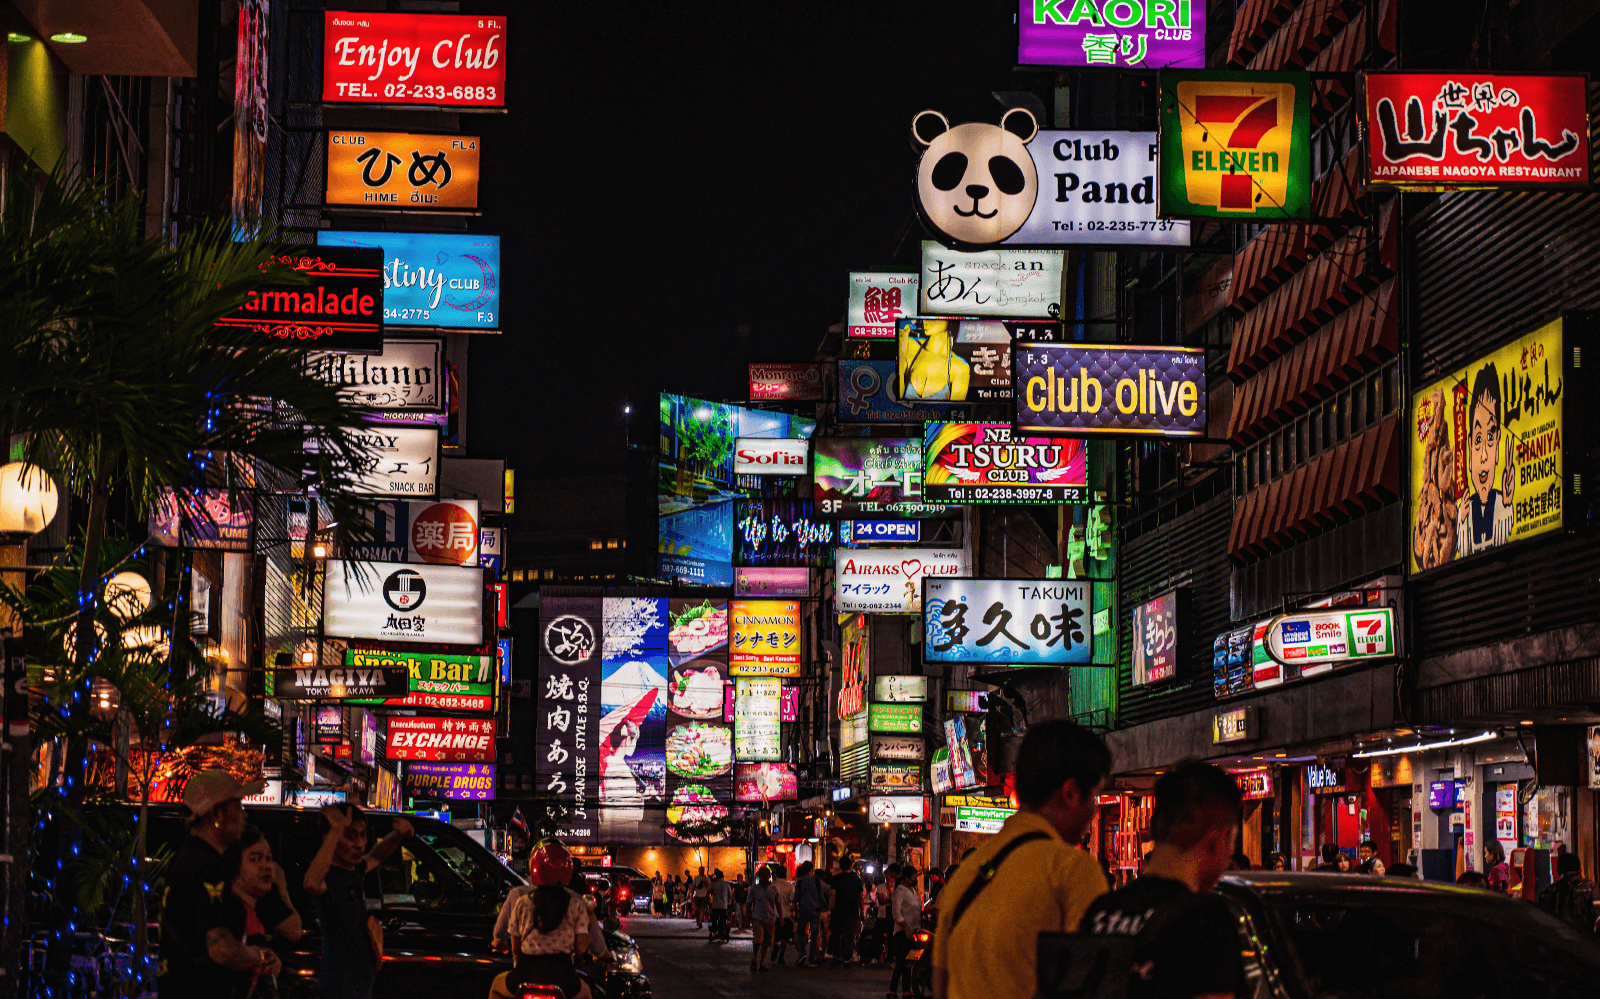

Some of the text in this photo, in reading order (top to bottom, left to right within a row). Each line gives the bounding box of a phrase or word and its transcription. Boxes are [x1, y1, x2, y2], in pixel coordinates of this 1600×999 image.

[1033, 0, 1192, 30] KAORI
[478, 21, 484, 29] 5
[1155, 29, 1192, 40] CLUB
[1082, 33, 1148, 65] 香り
[334, 34, 500, 81] Enjoy Club
[336, 83, 496, 100] TEL. 02-233-6883
[1438, 81, 1519, 113] 世界の
[1376, 96, 1579, 163] 山ちゃん
[332, 135, 365, 145] CLUB
[452, 141, 476, 150] FL4
[1053, 138, 1120, 161] Club
[1196, 95, 1277, 208] 7
[355, 147, 452, 189] ひめ
[1374, 166, 1582, 178] JAPANESE NAGOYA RESTAURANT
[1054, 172, 1154, 204] Pand
[364, 192, 398, 202] HIME
[1052, 221, 1074, 231] Tel
[1087, 221, 1175, 232] 02-235-7737
[383, 258, 448, 309] stiny
[449, 278, 480, 290] CLUB
[927, 260, 991, 304] あん
[239, 286, 374, 315] armalade
[383, 308, 430, 319] 34-2775
[477, 312, 494, 322] F.3
[751, 369, 805, 381] Monroe
[978, 390, 992, 398] Tel
[1026, 367, 1198, 416] club olive
[1503, 359, 1563, 428] 山ちゃん
[867, 411, 880, 419] Tel
[951, 411, 965, 419] F4
[984, 428, 1026, 443] NE
[1516, 428, 1561, 465] THANIYA
[737, 449, 804, 465] Sofia
[951, 445, 1062, 467] TSURU
[864, 457, 921, 469] Club Aur
[987, 469, 1029, 481] CLUB
[1520, 454, 1556, 486] BRANCH
[389, 482, 434, 493] SNACK BAR
[949, 488, 1079, 499] Tel 02-238-3997-8 F2
[822, 500, 842, 513] 3F
[858, 502, 884, 512] TEL.
[886, 503, 904, 511] 062
[218, 528, 248, 539] YUME
[416, 521, 475, 551] 薬局
[738, 515, 832, 550] Up to You
[857, 524, 916, 535] 24 OPEN
[922, 565, 958, 575] CLUB
[842, 583, 891, 595] アイラック
[1019, 587, 1083, 600] TAKUMI
[735, 615, 794, 625] CINNAMON
[1315, 623, 1340, 632] BOOK
[734, 630, 796, 648] シナモン
[1315, 630, 1342, 639] Smile
[430, 659, 473, 682] Bar
[295, 669, 386, 686] NAGIYA
[306, 687, 333, 696] TOKYO
[424, 696, 484, 708] 02-652-5465
[575, 715, 587, 750] STYLE
[391, 732, 490, 750] EXCHANGE
[876, 741, 922, 752] ナンバーワン
[406, 774, 493, 789] PURPLE DRUGS
[1307, 765, 1337, 788] Value Plus
[972, 809, 1004, 818] FamilyMart
